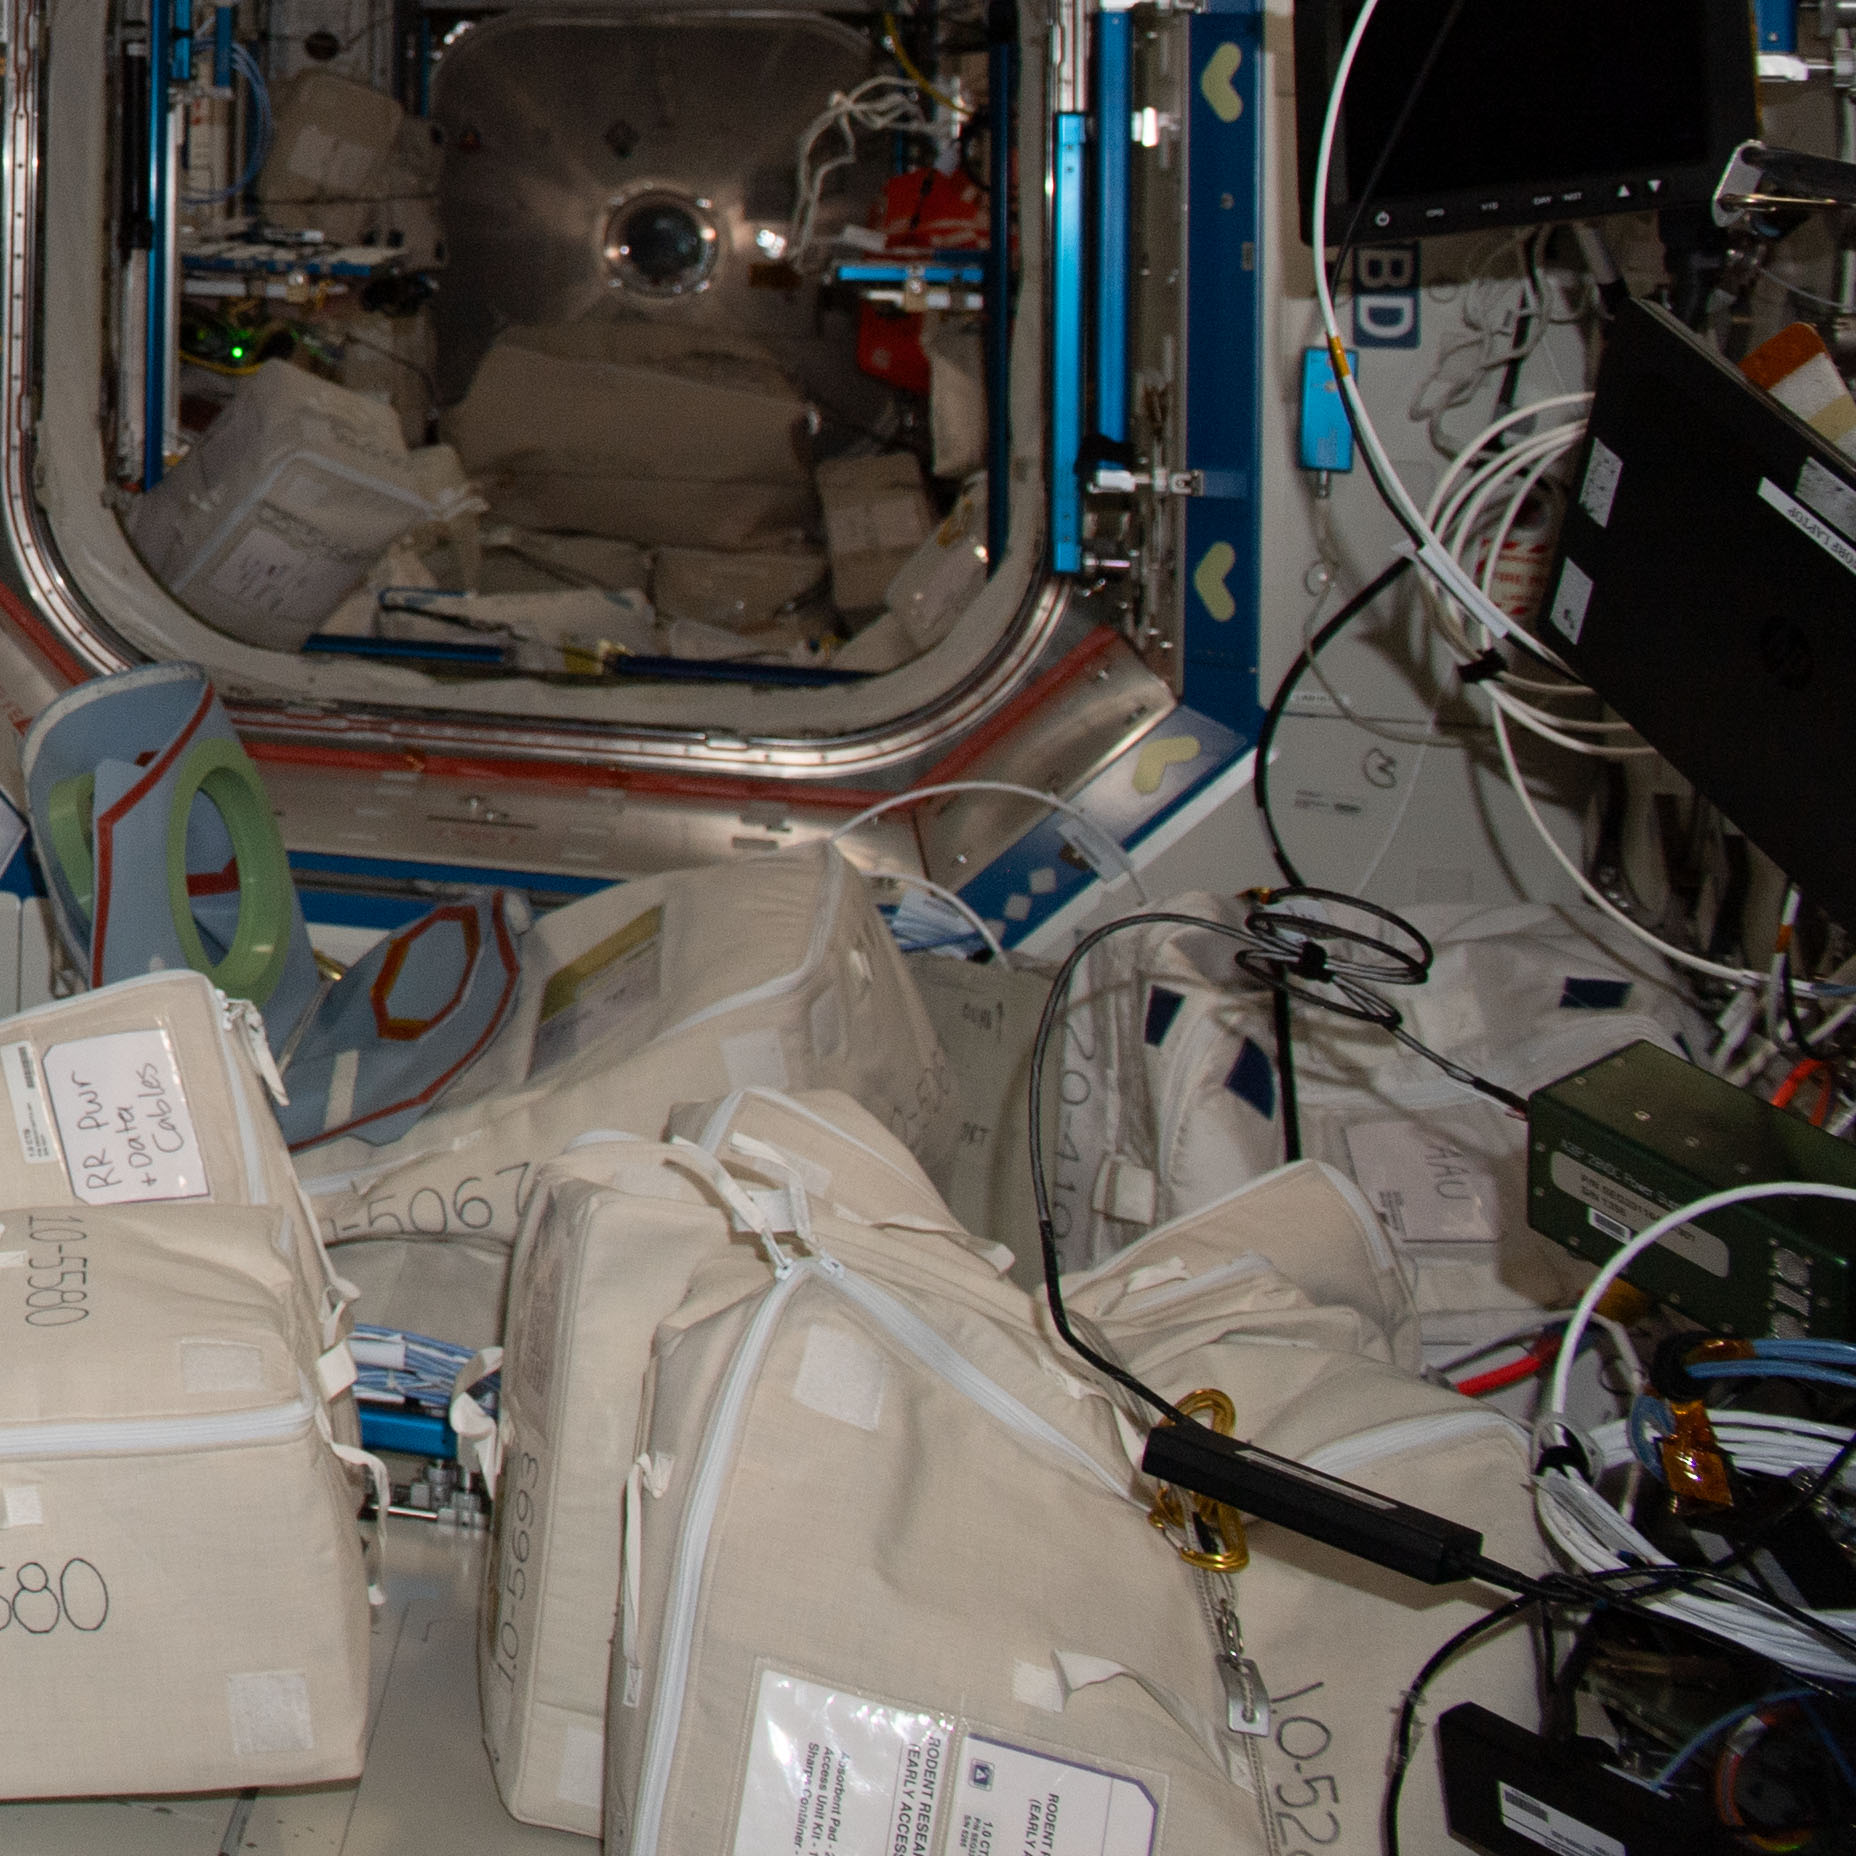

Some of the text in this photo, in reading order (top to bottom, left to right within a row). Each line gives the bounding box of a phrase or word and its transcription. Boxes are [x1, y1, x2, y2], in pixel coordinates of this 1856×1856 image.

[920, 1735, 941, 1799] RODENT
[1269, 1680, 1342, 1856] 1.0-52
[1044, 1793, 1061, 1849] RODENT
